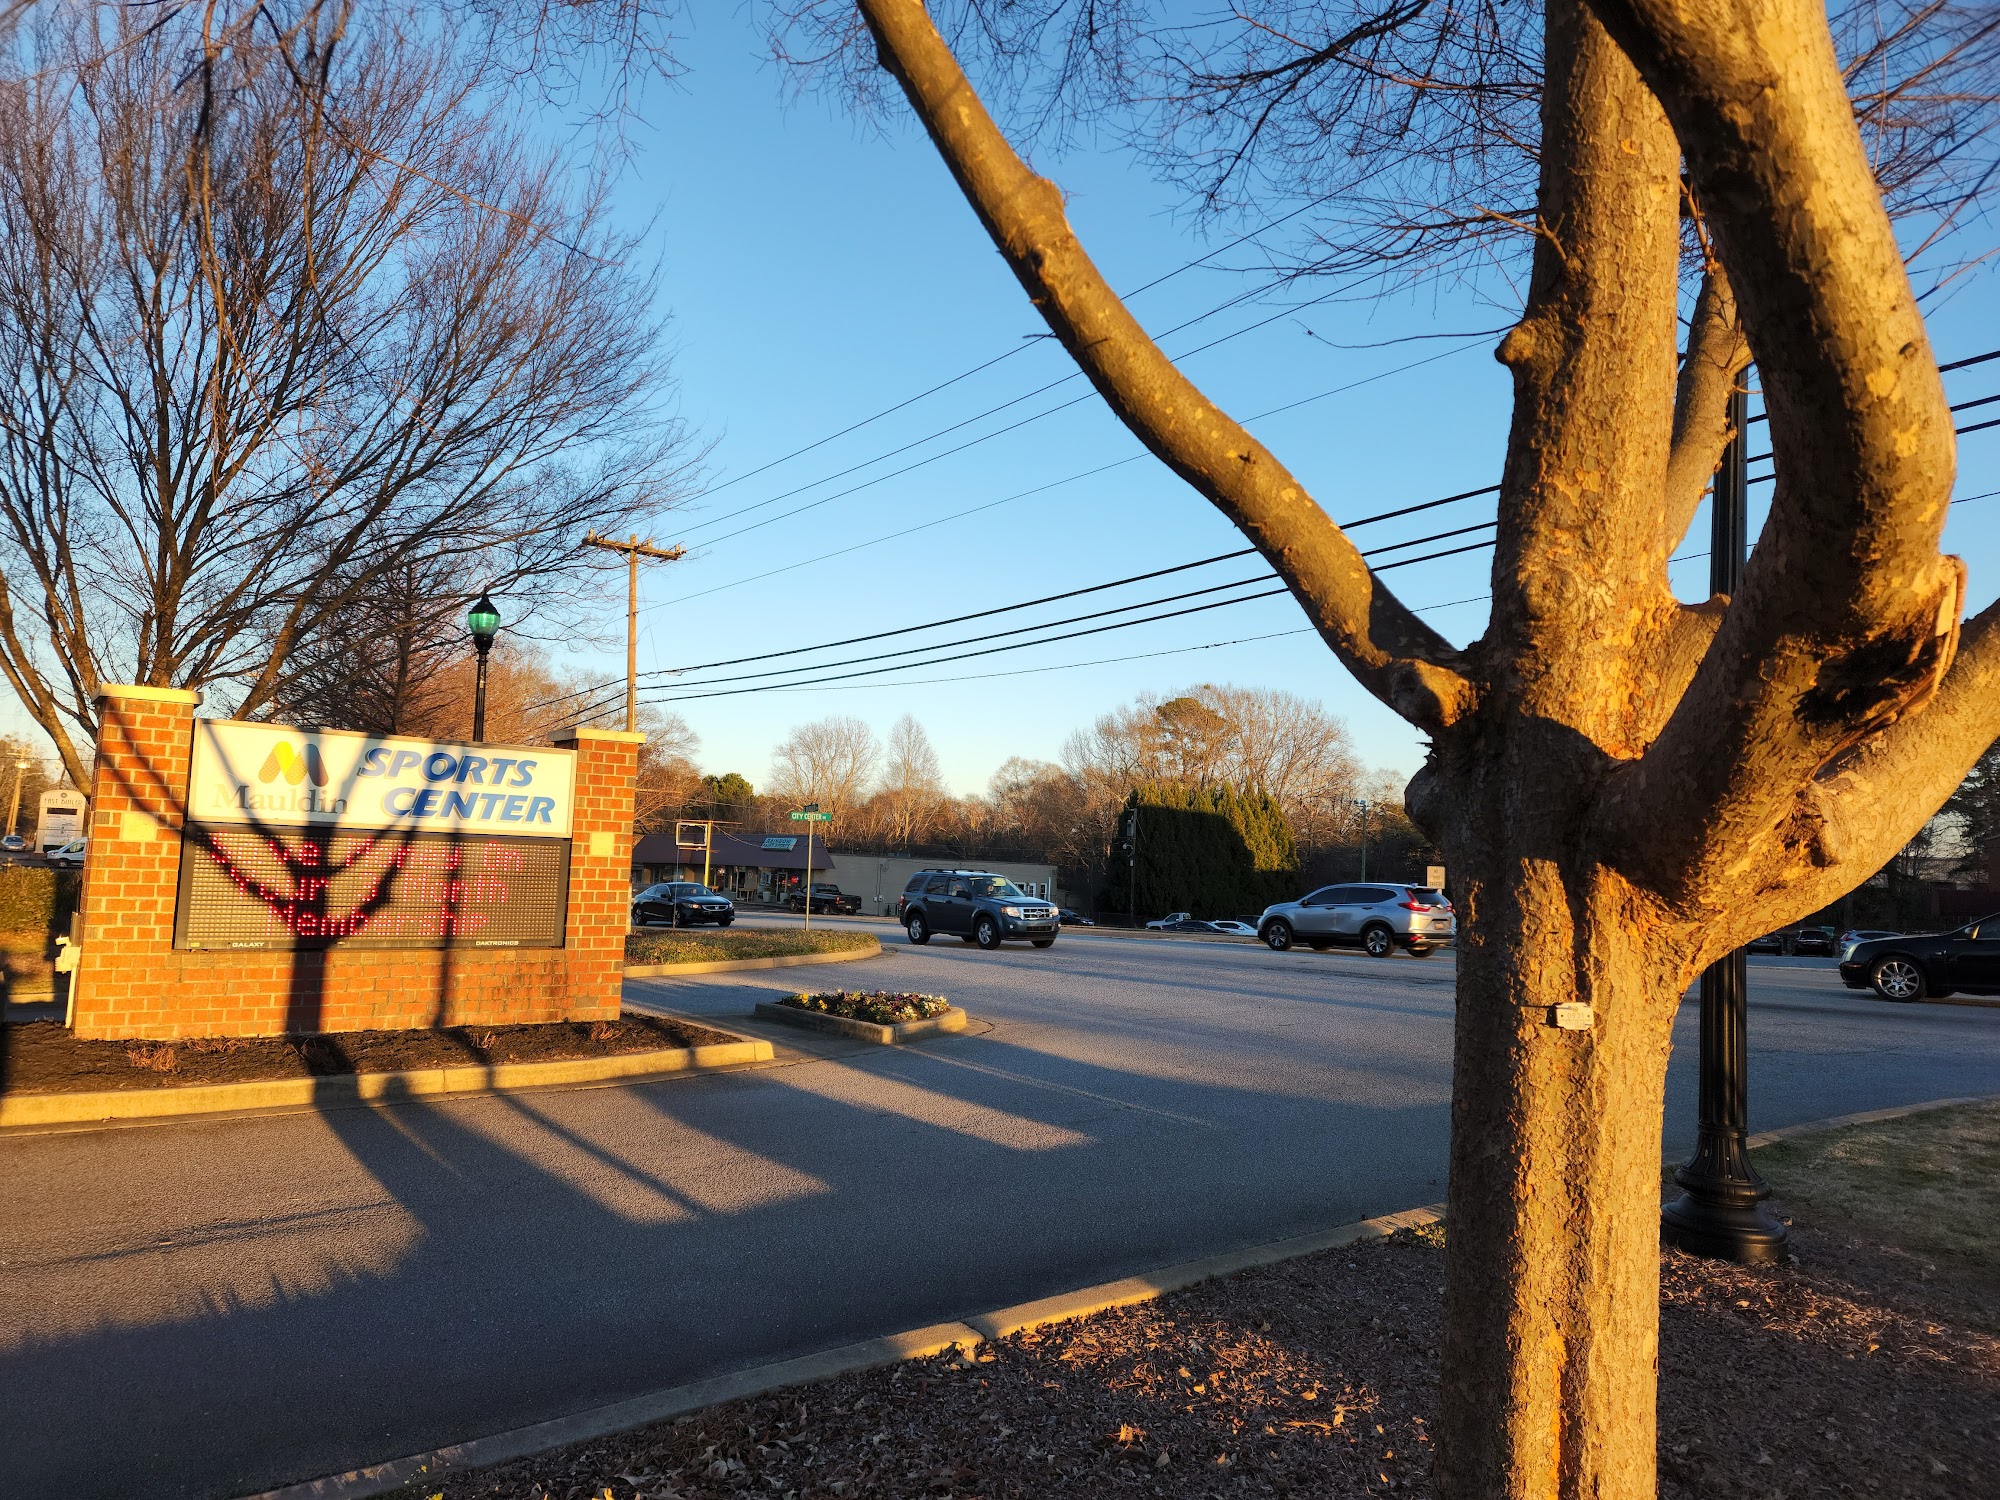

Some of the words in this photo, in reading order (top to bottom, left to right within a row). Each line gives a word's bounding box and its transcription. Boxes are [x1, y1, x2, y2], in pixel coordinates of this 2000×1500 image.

[357, 748, 537, 788] SPORTS
[213, 783, 350, 815] Mauldin
[382, 787, 556, 824] CENTER
[791, 812, 804, 820] CITY
[345, 836, 460, 870] Money
[483, 840, 523, 872] On
[402, 873, 509, 903] Month
[266, 903, 489, 936] Membership
